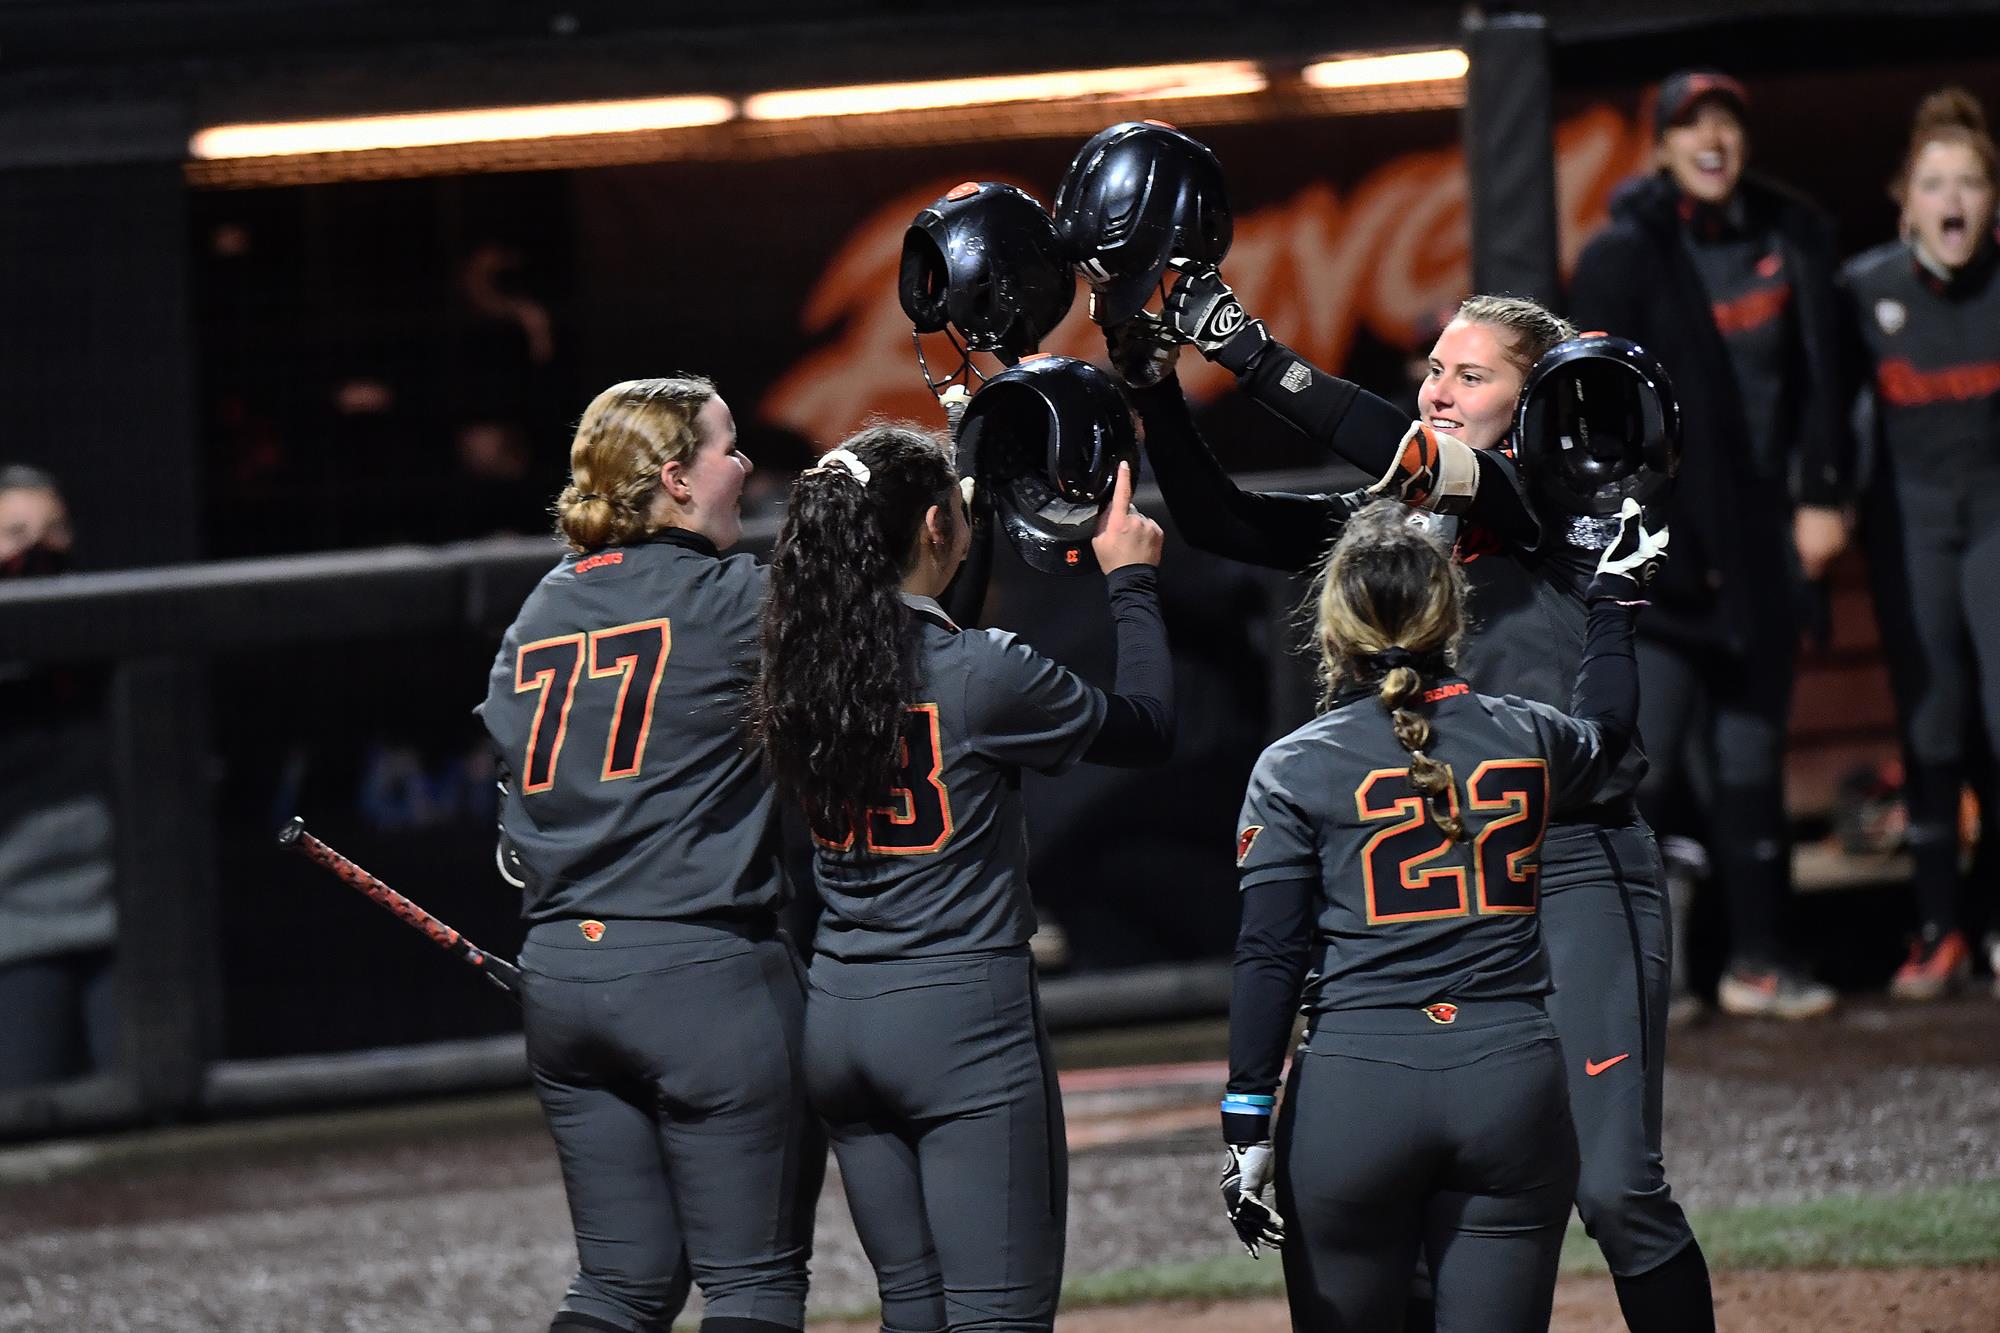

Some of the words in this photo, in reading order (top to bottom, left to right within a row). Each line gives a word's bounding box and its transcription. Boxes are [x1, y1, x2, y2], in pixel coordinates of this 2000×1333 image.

[514, 617, 672, 796] 77
[810, 703, 954, 856] 3
[1354, 758, 1549, 925] 22
